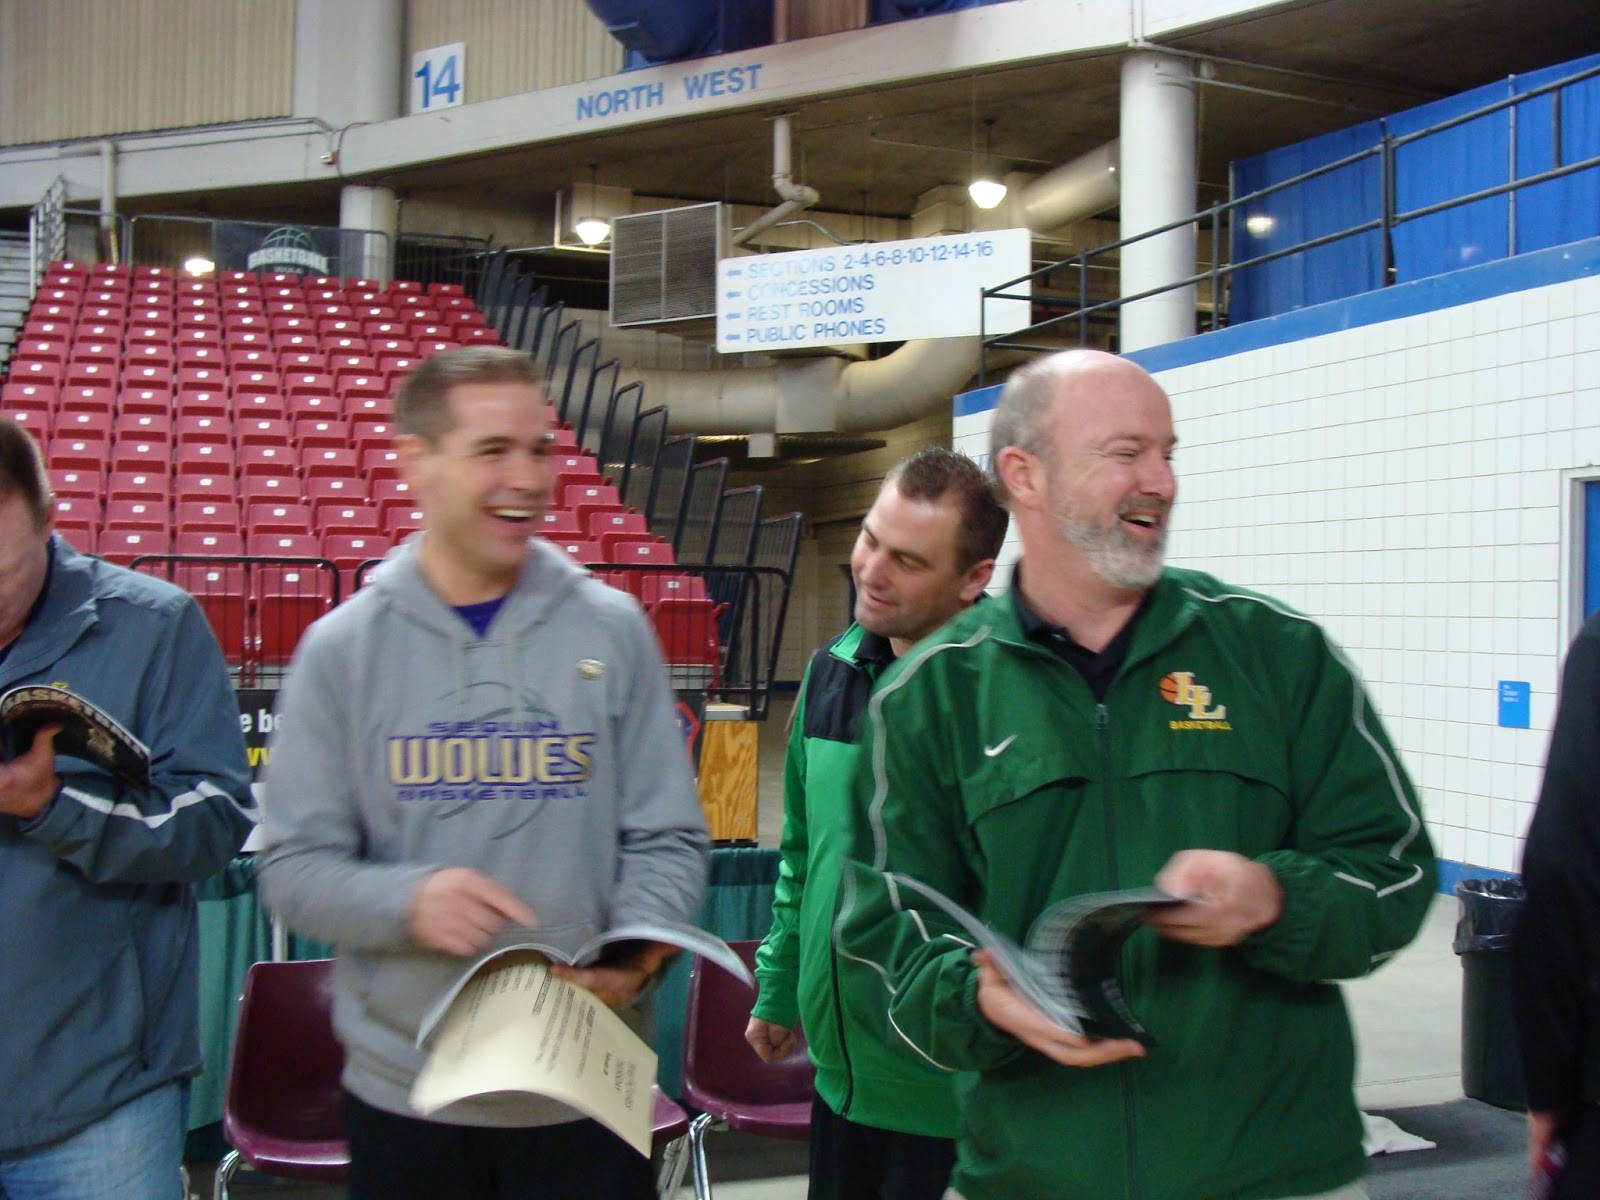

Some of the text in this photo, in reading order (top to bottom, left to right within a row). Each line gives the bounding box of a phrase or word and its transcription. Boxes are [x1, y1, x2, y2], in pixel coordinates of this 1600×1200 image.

[414, 54, 461, 109] 14
[577, 63, 763, 121] NORTH WEST
[747, 240, 994, 279] SECTIONS 2-4-6-8-10-12-14-16
[747, 273, 875, 301] CONCESSIONS
[747, 297, 865, 321] REST ROOMS
[747, 317, 886, 343] PUBLIC PHONES
[387, 732, 598, 788] WOLVES
